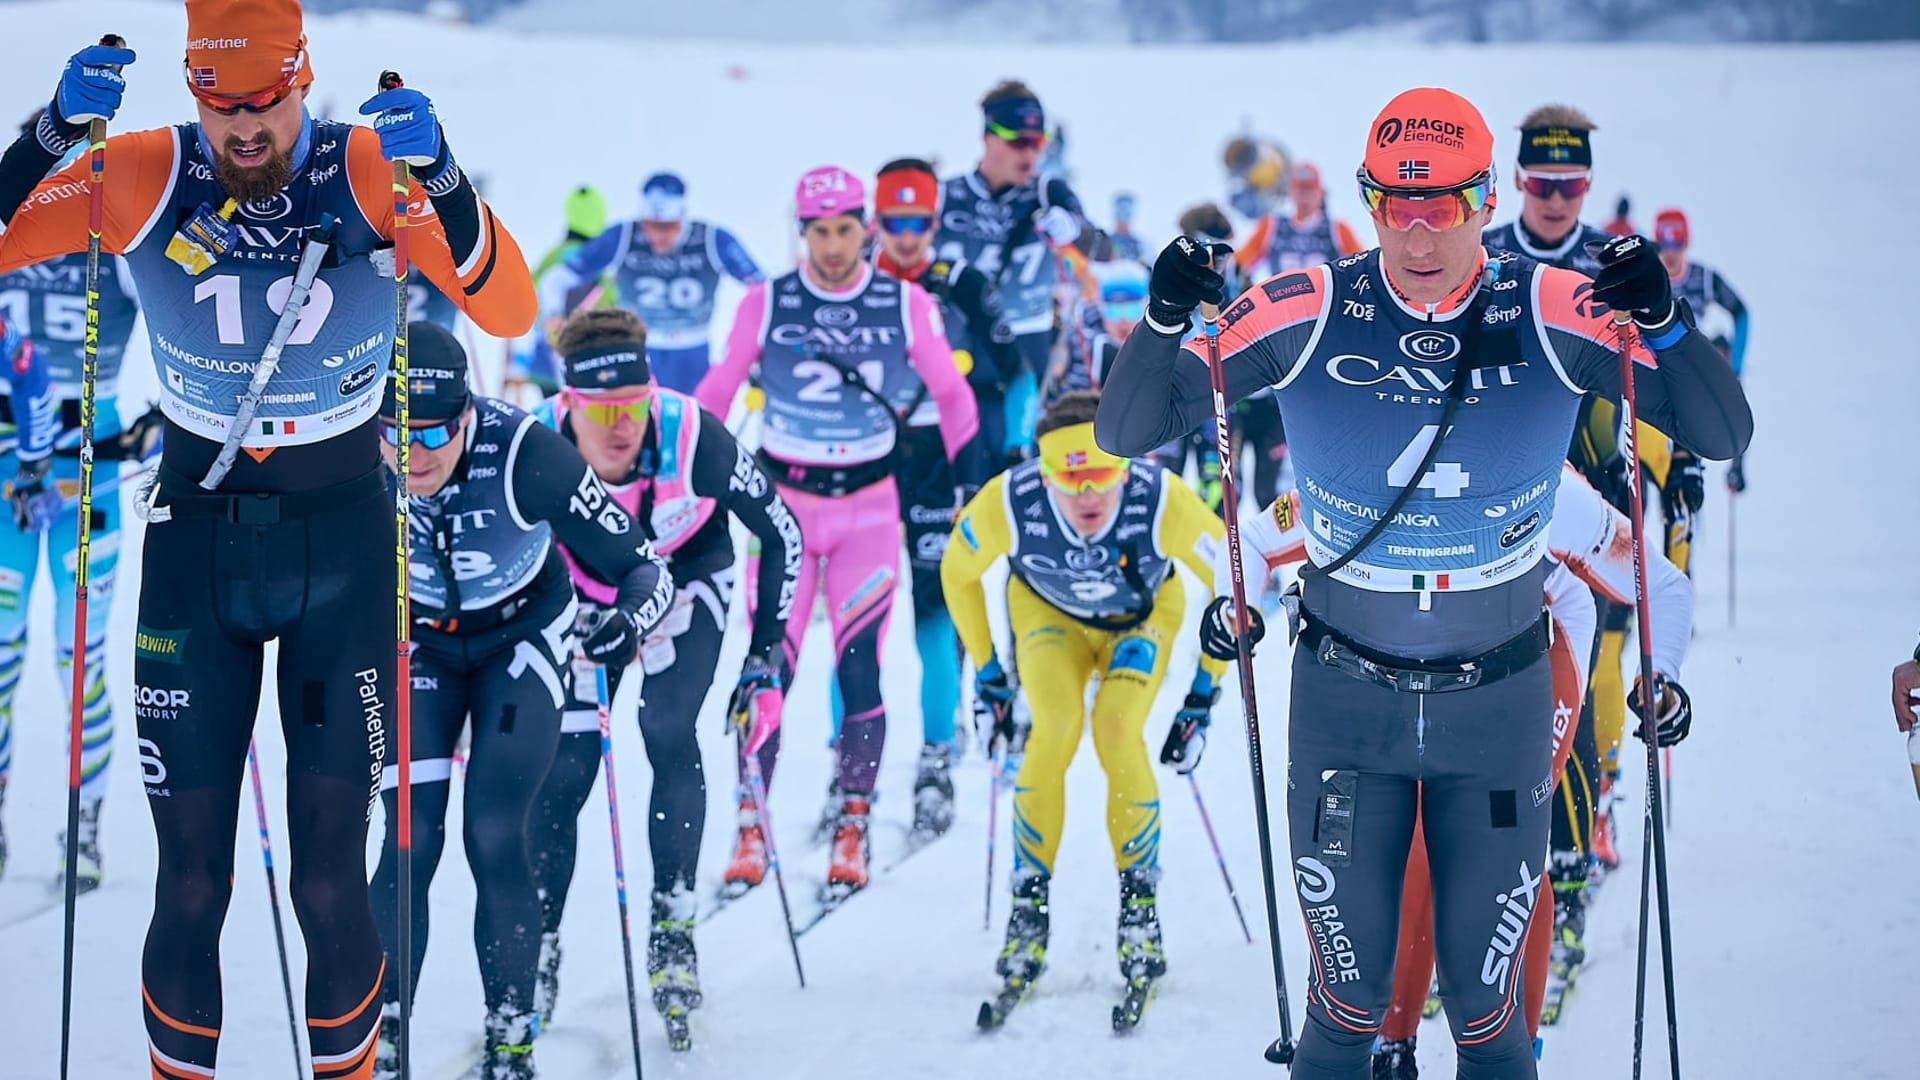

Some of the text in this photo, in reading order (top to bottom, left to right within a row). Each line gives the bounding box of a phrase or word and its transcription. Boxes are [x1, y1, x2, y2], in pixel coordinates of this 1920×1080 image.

[1404, 130, 1465, 150] Eiendom
[1405, 118, 1465, 140] RAGDE
[233, 250, 301, 263] RENTO
[633, 276, 704, 310] 20
[1269, 282, 1312, 299] NEWSEC
[0, 289, 87, 342] 15
[193, 273, 334, 346] 19
[1343, 299, 1366, 320] 70
[86, 289, 100, 355] LEKI
[347, 332, 385, 359] VISMA
[385, 368, 455, 380] MELVEN
[1375, 391, 1480, 405] TRENO
[186, 409, 225, 429] EDITION
[1386, 424, 1471, 498] 4
[1386, 543, 1476, 558] TRENTINGRANA
[1306, 907, 1338, 985] Eiendom
[1318, 903, 1361, 984] RAGDE
